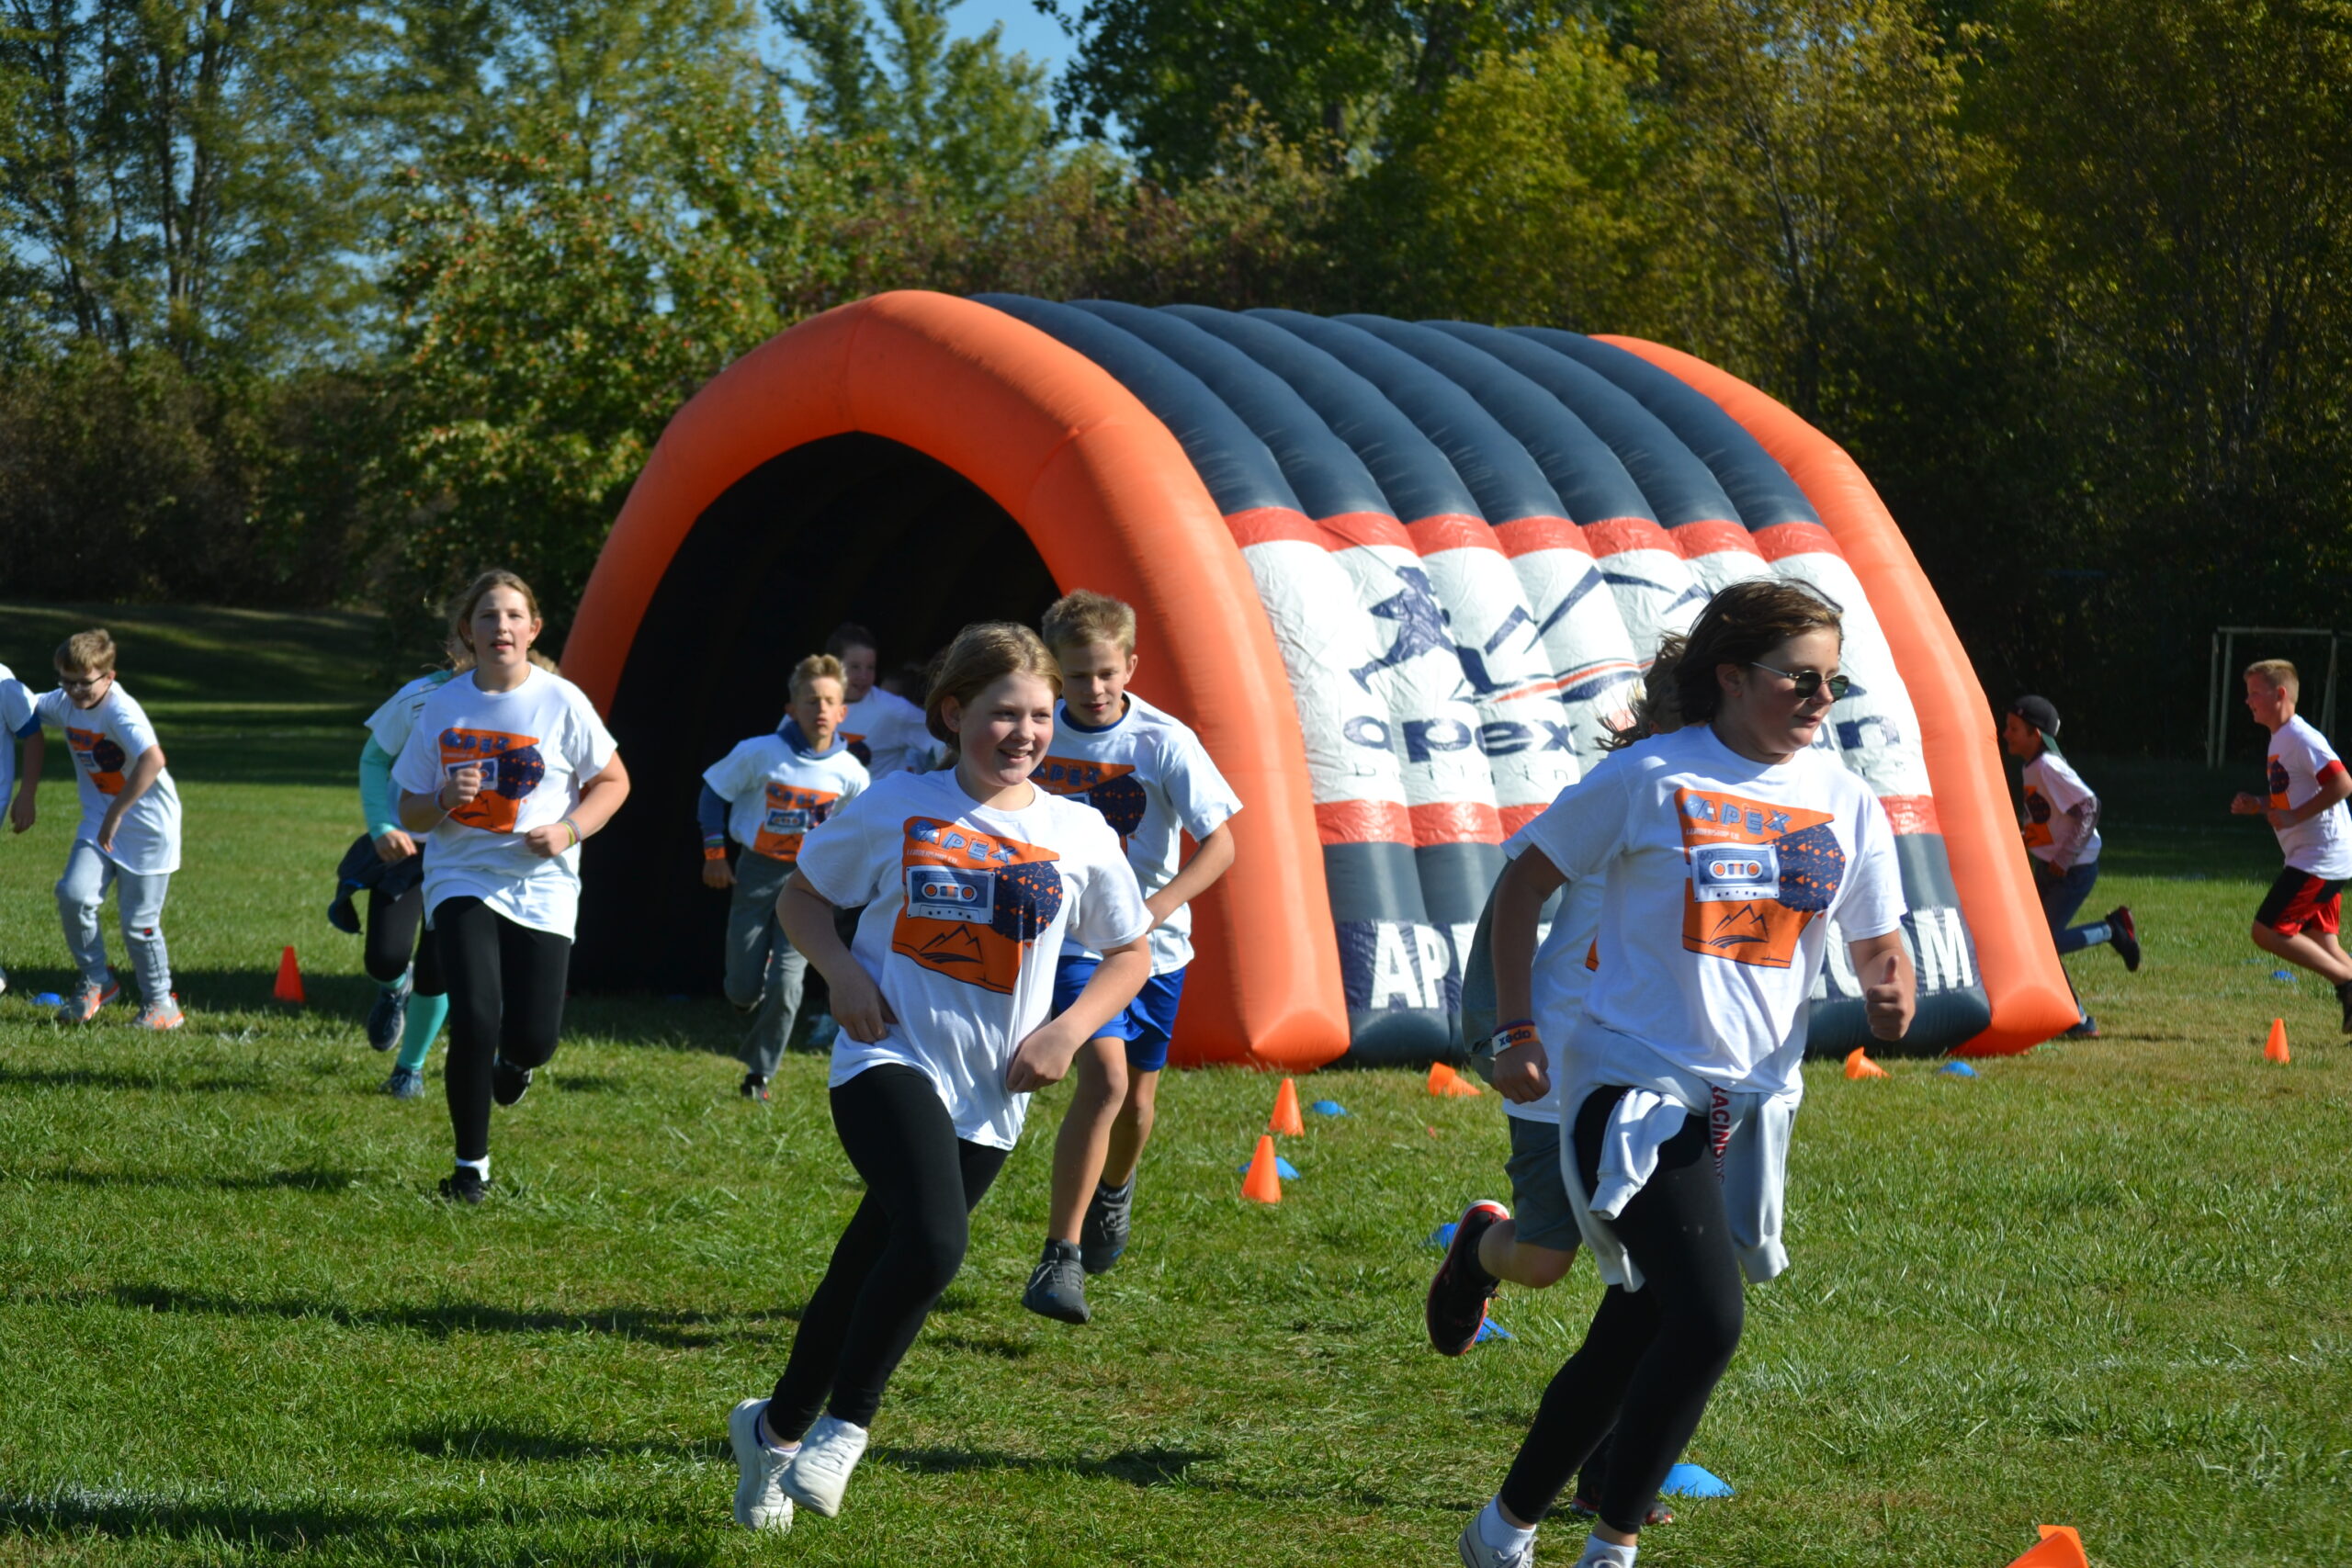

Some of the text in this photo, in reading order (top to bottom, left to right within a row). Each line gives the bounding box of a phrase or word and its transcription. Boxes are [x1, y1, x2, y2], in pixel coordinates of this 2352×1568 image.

[1343, 715, 1584, 763] apex
[1682, 794, 1792, 835] APEX
[909, 819, 1018, 864] APEX
